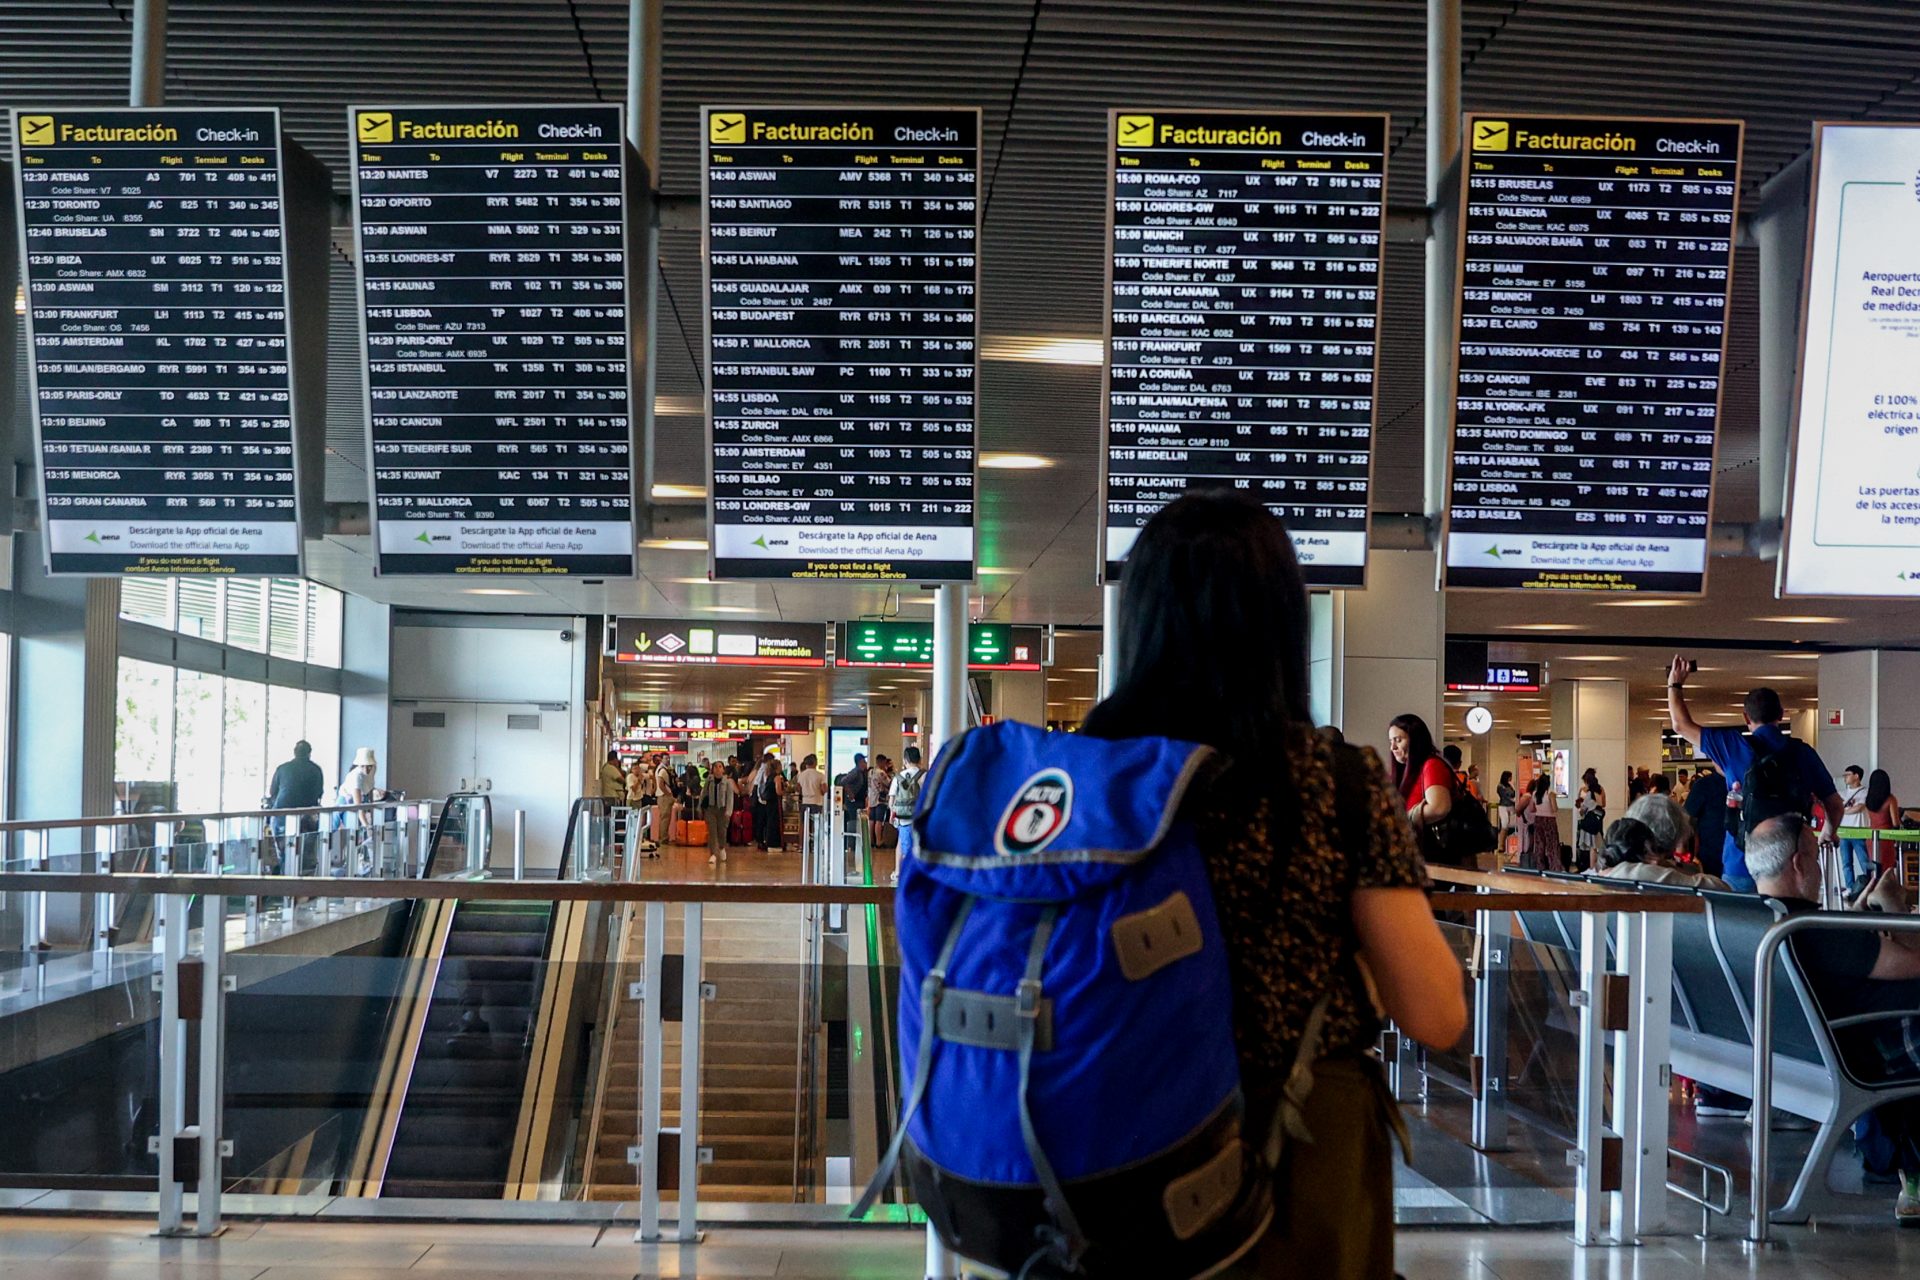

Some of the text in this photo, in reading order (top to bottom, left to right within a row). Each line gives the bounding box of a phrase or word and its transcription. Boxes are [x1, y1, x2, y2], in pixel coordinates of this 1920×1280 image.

[62, 124, 258, 141] Facturación Check-in
[400, 121, 601, 138] Facturación Check-in
[753, 122, 958, 141] Facturación Check-in
[1161, 125, 1365, 146] Facturación Check-in
[1516, 131, 1719, 153] Facturación Check-in
[161, 156, 182, 165] Flight
[855, 156, 878, 164] Flight
[939, 156, 963, 164] Desks
[1120, 157, 1369, 169] Time To Flight Terminal Desks
[23, 173, 49, 181] 12:30
[50, 173, 89, 181] ATENAS
[146, 173, 160, 181] A3
[179, 173, 195, 181] 701
[205, 173, 217, 181] T2
[227, 173, 245, 181] 408
[260, 173, 276, 181] 411
[360, 171, 385, 179] 13:20
[387, 170, 428, 179] NANTES
[485, 169, 499, 178] V7
[514, 169, 537, 178] 2273
[545, 169, 558, 178] T2
[569, 169, 585, 178] 401
[602, 169, 619, 178] 402
[710, 172, 736, 180] 14:40
[738, 171, 776, 180] ASWAN
[839, 172, 862, 181] AMV
[868, 172, 891, 181] 5368
[900, 172, 911, 181] T1
[924, 173, 941, 182] 340
[957, 173, 974, 182] 342
[1116, 174, 1380, 188] 15:00 ROMA-FCO UX 1047 T2 516 to 532
[1471, 179, 1733, 195] 15:15 BRUSELAS UX 1173 T2 505 to 532
[1871, 286, 1895, 296] Real
[1863, 301, 1875, 310] de
[1459, 374, 1485, 383] 15:30
[1487, 375, 1530, 384] CANCUN
[1585, 377, 1606, 386] EVE
[1644, 379, 1656, 387] T1
[1667, 380, 1685, 388] 225
[1688, 379, 1697, 388] to
[1699, 380, 1717, 389] 229
[38, 391, 64, 399] 13:05
[65, 391, 122, 400] PARIS-ORLY
[160, 392, 174, 400] TO
[217, 392, 230, 400] T2
[239, 393, 256, 401] 421
[259, 393, 270, 401] to
[271, 393, 289, 401] 423
[372, 391, 396, 399] 14:30
[399, 391, 458, 399] LANZAROTE
[495, 390, 516, 399] RYR
[523, 390, 545, 399] 2017
[554, 390, 566, 399] T1
[577, 391, 594, 399] 354
[609, 391, 626, 399] 360
[714, 393, 739, 402] 14:55
[741, 394, 779, 402] LISBOA
[840, 394, 854, 403] UX
[869, 395, 891, 403] 1155
[899, 395, 912, 404] T2
[923, 396, 940, 404] 505
[956, 396, 972, 405] 532
[1874, 395, 1917, 405] El 100%
[1868, 410, 1913, 419] eléctrica
[1111, 422, 1369, 437] 15:10 PANAMA UX 055 T1 216 to 222
[1884, 424, 1918, 436] origen
[1859, 486, 1919, 497] Las puertas
[1856, 500, 1869, 509] de
[1873, 500, 1886, 509] los
[1882, 514, 1920, 526] la temp
[799, 531, 845, 541] Descárgate
[858, 532, 873, 541] App
[876, 532, 901, 540] oficial
[799, 546, 838, 554] Download
[856, 546, 882, 555] official
[885, 547, 905, 555] Aena
[907, 547, 923, 556] App
[874, 563, 890, 571] flight
[758, 638, 798, 646] Information
[758, 646, 811, 656] Información
